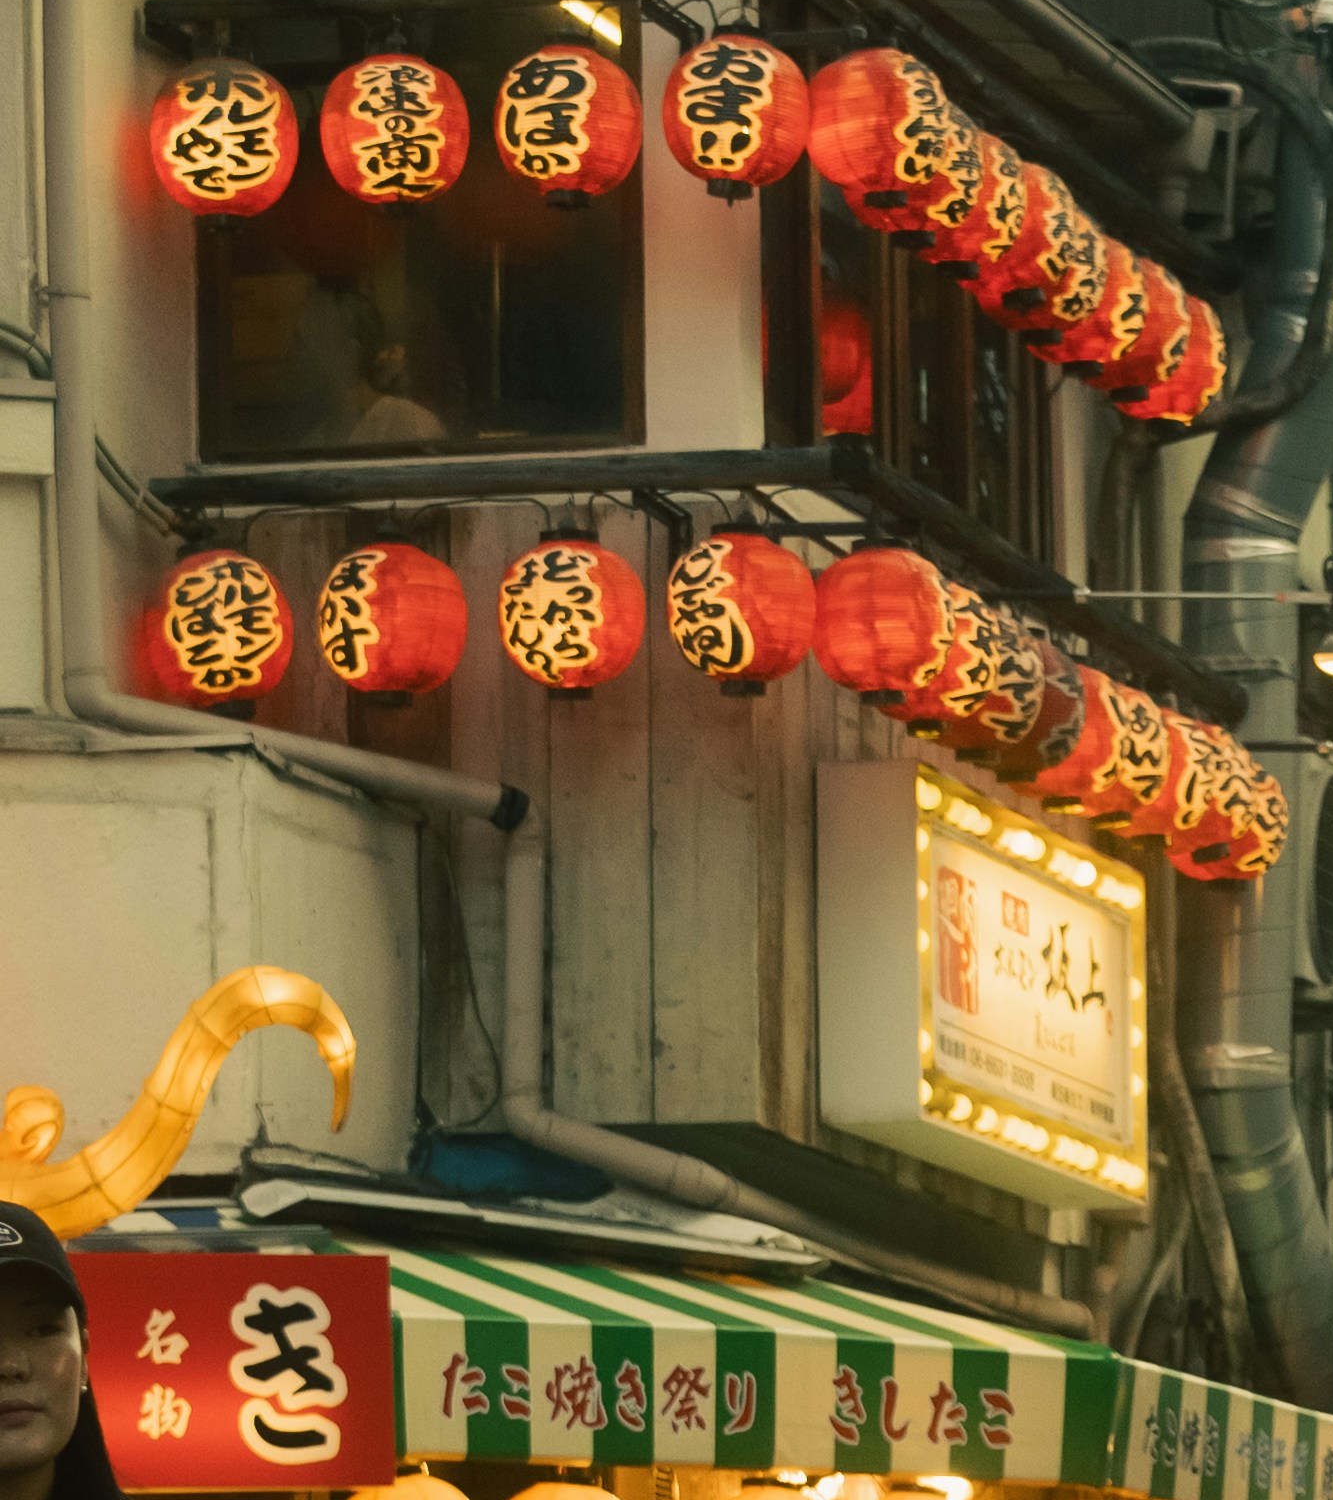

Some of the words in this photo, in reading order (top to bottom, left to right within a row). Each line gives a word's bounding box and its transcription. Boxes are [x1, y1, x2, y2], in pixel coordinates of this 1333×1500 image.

[506, 57, 586, 174] あほか
[137, 1307, 192, 1440] 名物
[442, 1352, 757, 1436] たこ焼き祭り
[829, 1366, 1016, 1448] きしたこ
